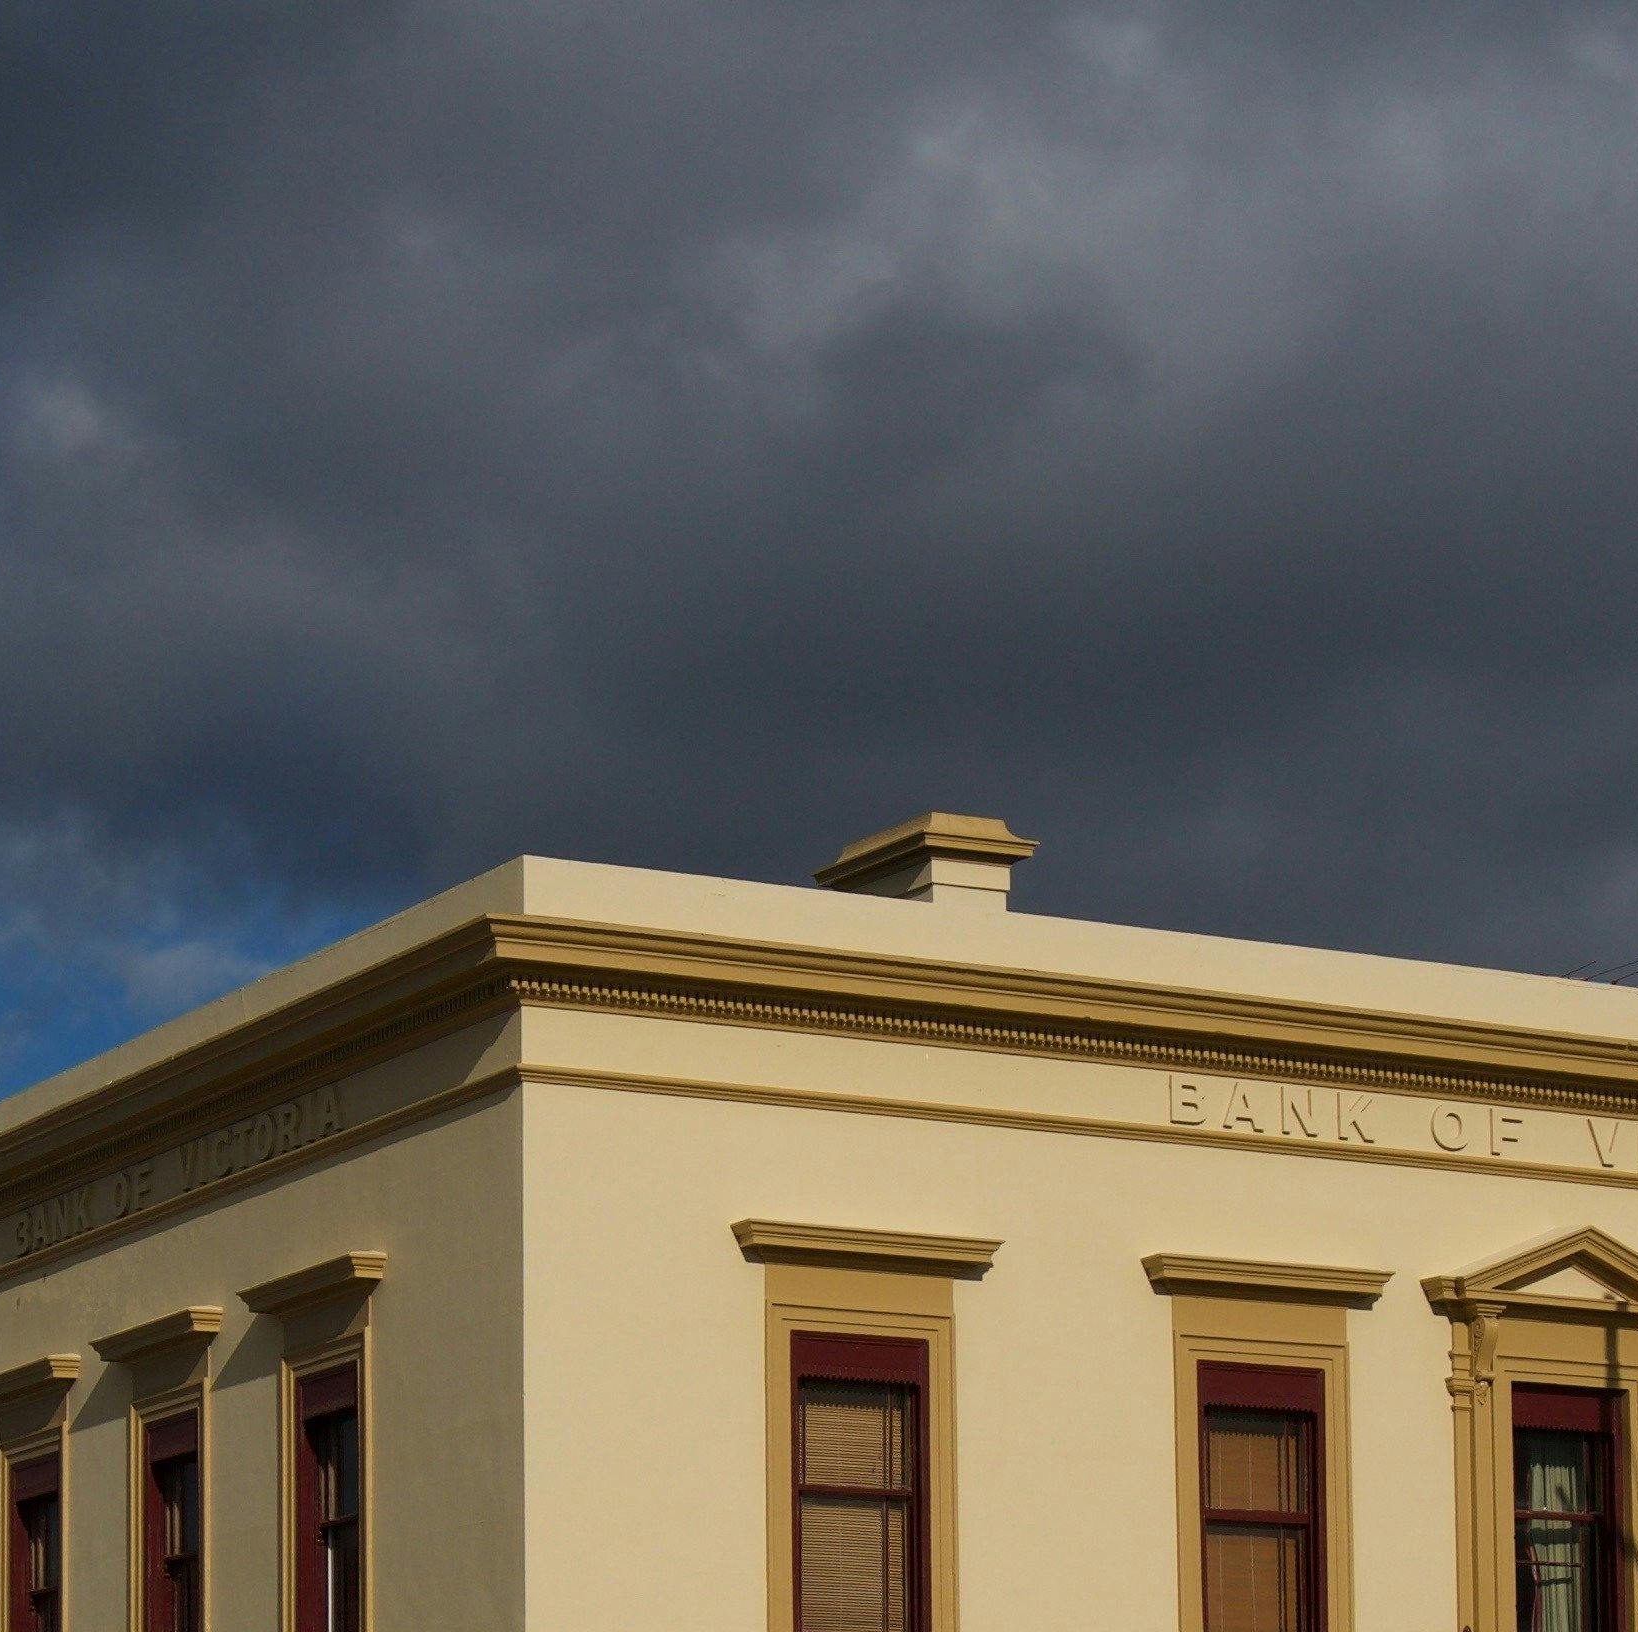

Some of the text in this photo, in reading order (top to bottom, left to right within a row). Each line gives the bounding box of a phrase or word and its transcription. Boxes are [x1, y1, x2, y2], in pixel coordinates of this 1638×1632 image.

[15, 1085, 344, 1257] BANK OF VICTORIA
[1167, 1074, 1376, 1143] BANK
[1430, 1103, 1523, 1156] OF
